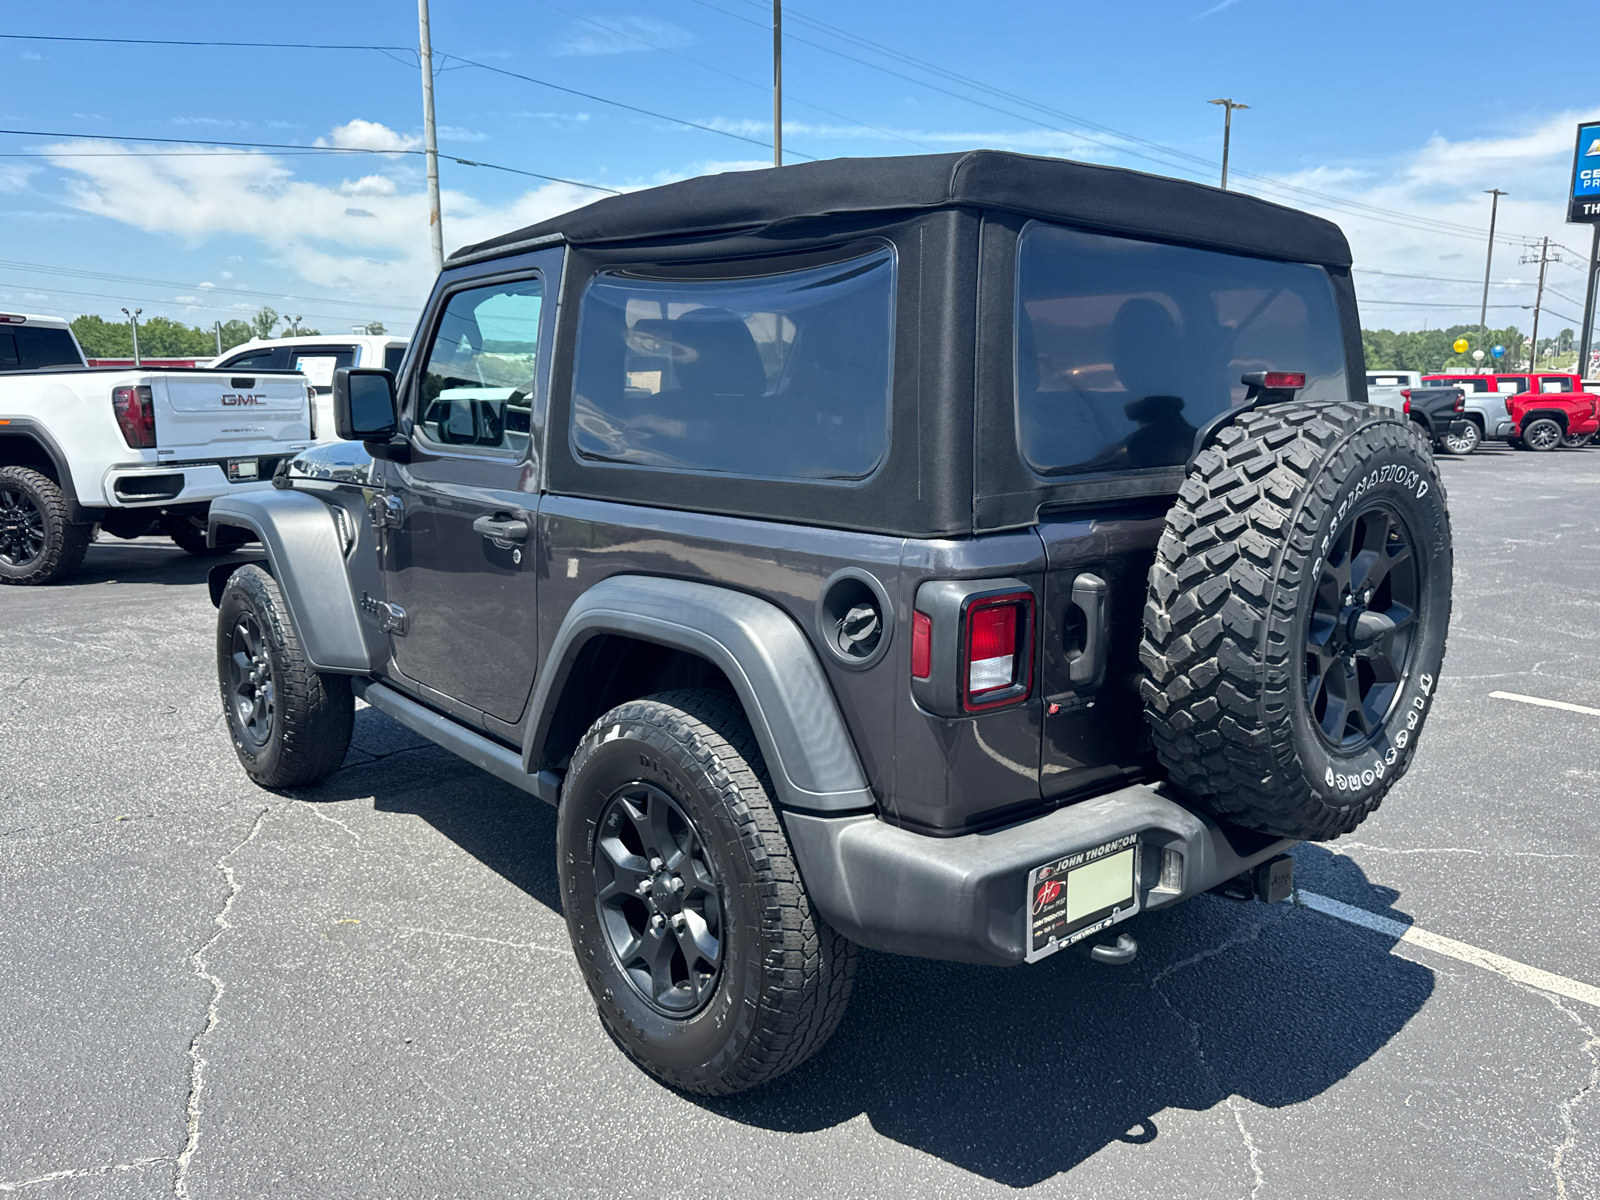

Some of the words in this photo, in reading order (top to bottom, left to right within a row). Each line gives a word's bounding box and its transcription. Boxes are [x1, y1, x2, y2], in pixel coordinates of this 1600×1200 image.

[1583, 204, 1600, 214] TH
[221, 394, 267, 406] GMC
[1312, 465, 1418, 581] DESTINATION
[1056, 853, 1084, 872] JOHN
[1070, 924, 1103, 943] CHEVROLET
